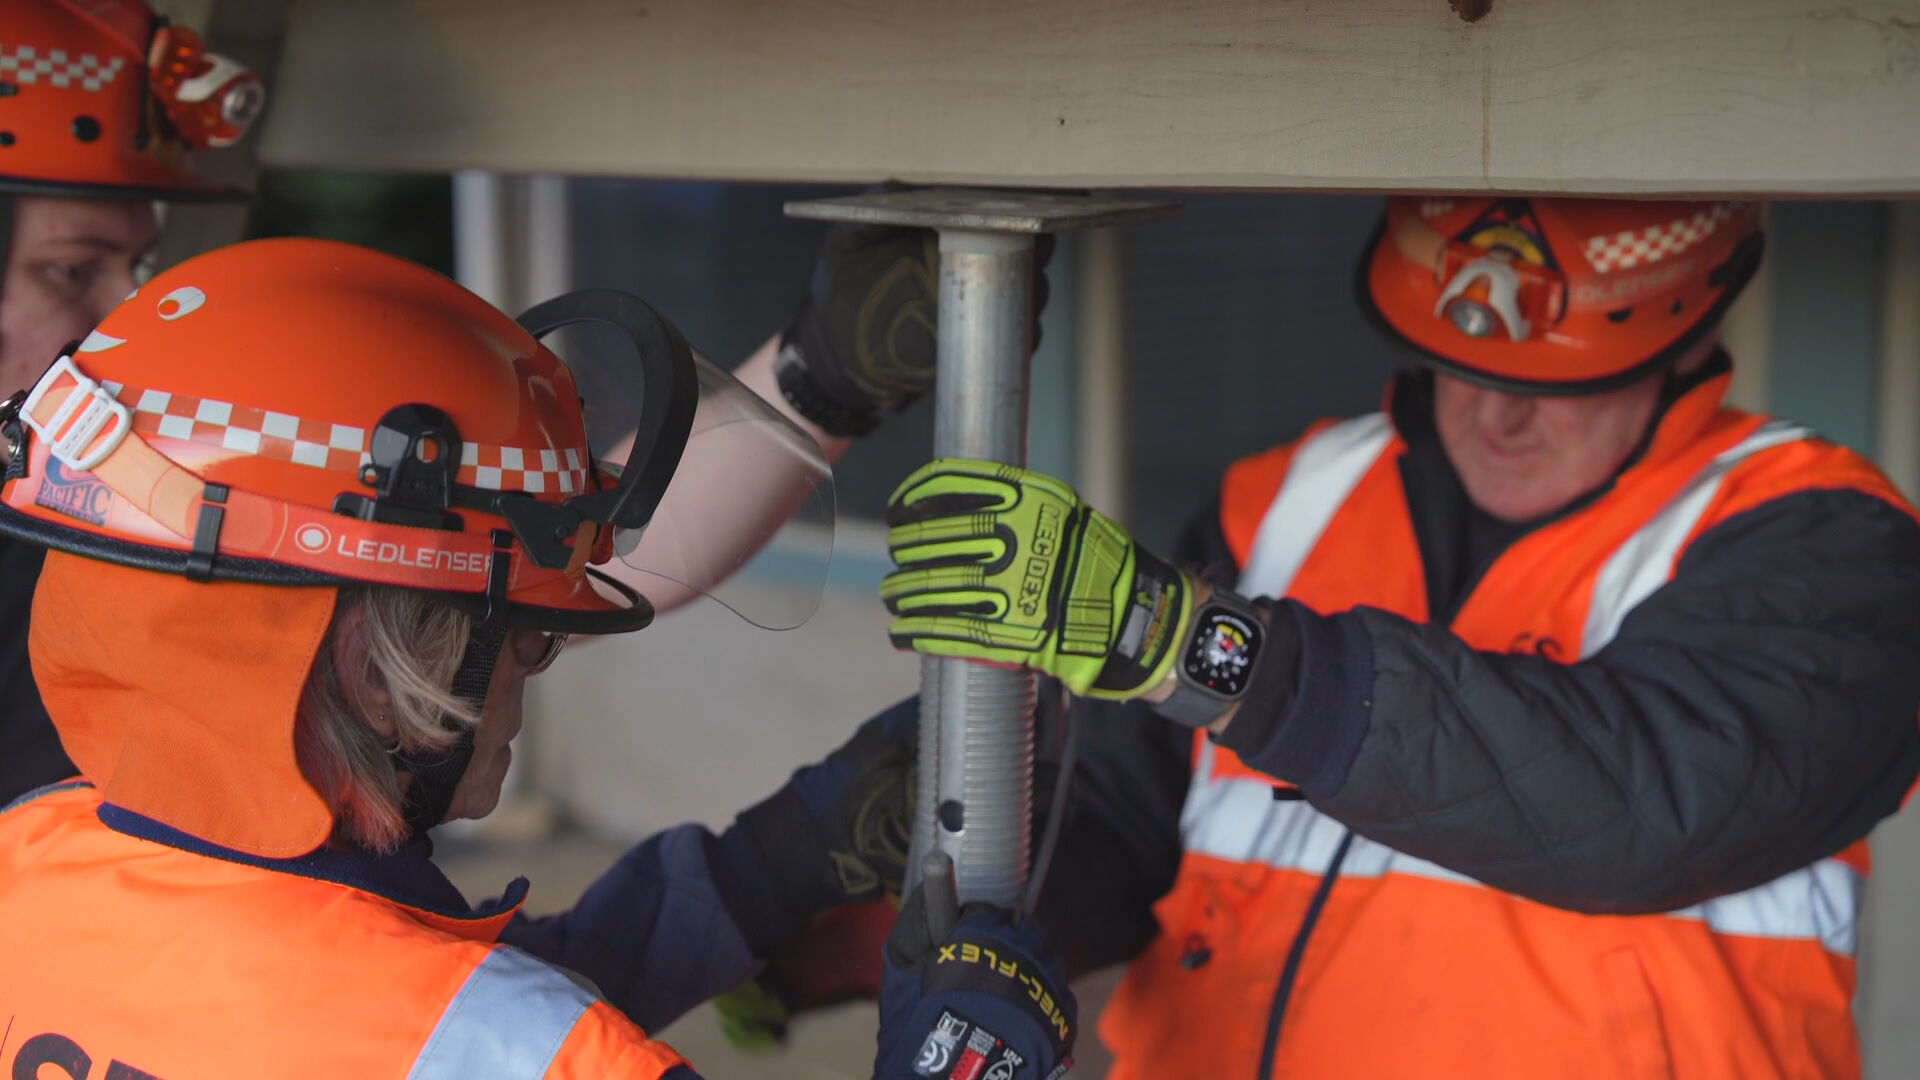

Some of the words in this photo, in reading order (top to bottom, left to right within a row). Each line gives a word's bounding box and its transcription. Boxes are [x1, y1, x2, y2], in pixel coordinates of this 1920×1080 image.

[36, 479, 113, 517] PACIFIC
[1032, 503, 1061, 557] MEC
[1017, 556, 1050, 608] DEX
[937, 943, 1069, 1041] MEC-FLEX
